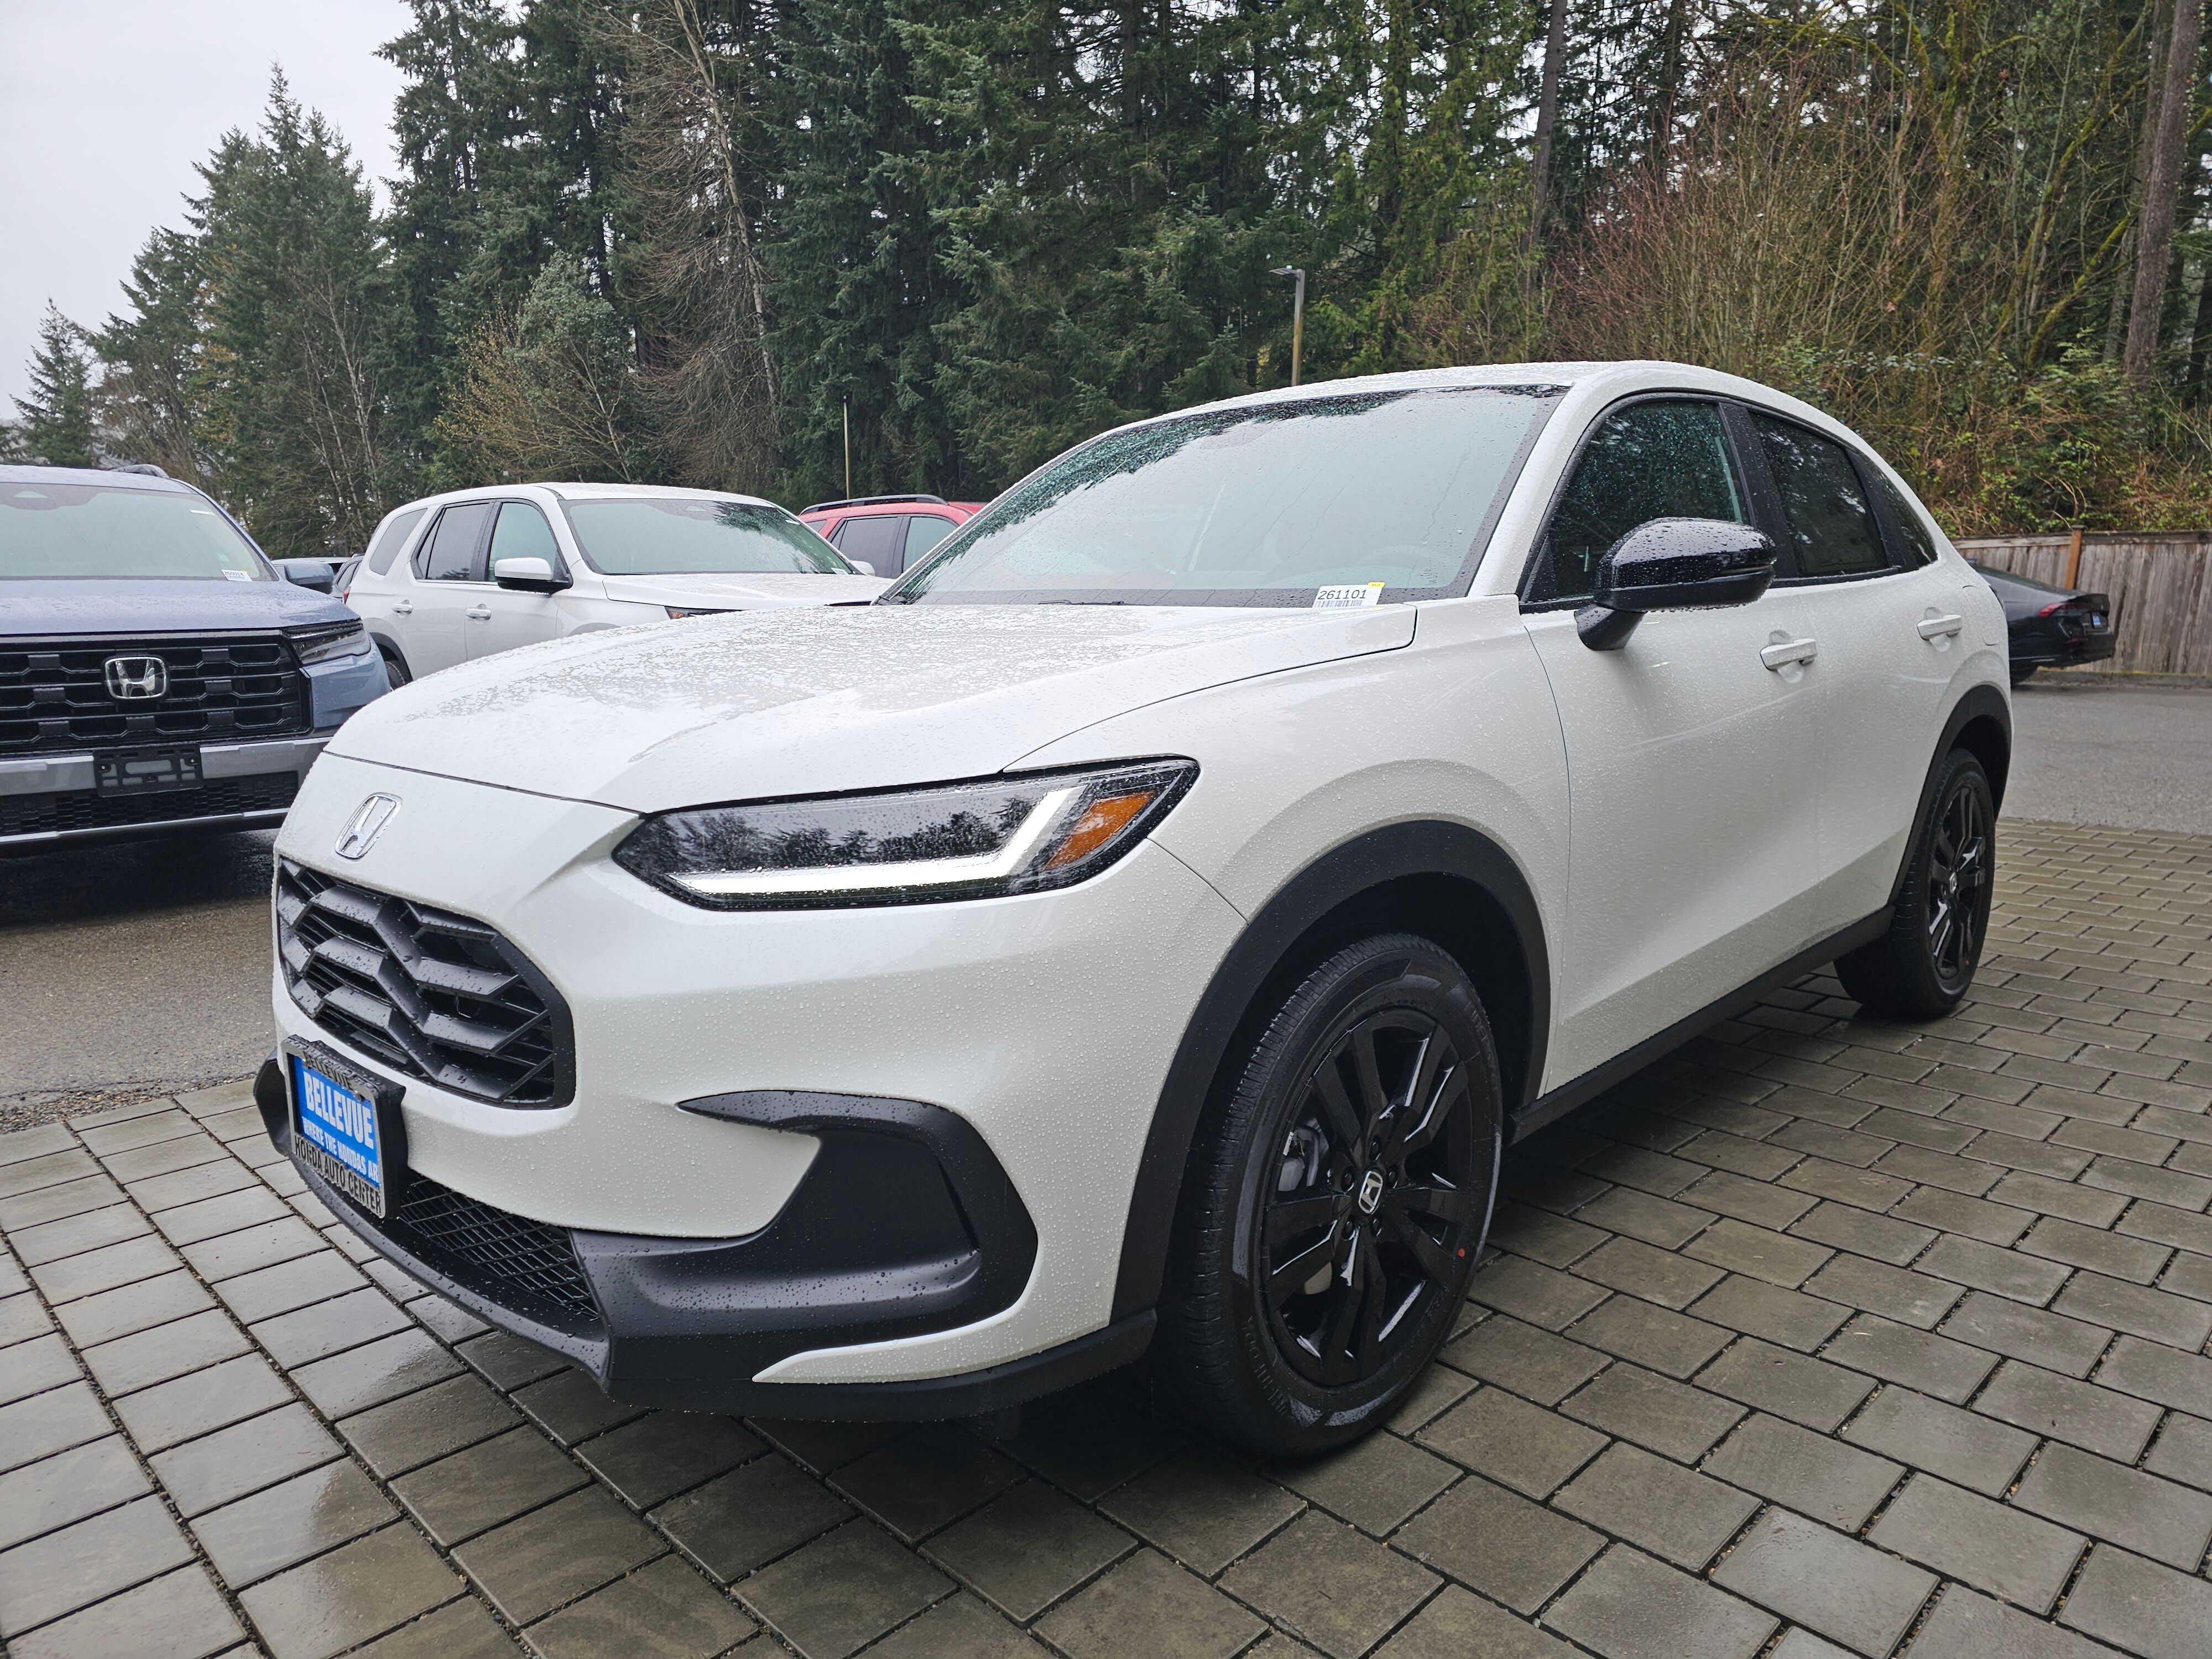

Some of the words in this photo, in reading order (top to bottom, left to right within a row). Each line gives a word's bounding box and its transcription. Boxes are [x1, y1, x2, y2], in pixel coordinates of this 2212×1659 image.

[1318, 589, 1366, 599] 261101
[304, 1071, 374, 1149] BELLEVUE
[295, 1135, 322, 1172] HONDA
[325, 1156, 345, 1187] AUTO
[348, 1172, 381, 1215] CENTER
[302, 1116, 325, 1146] WHERE
[324, 1131, 337, 1156] THE
[337, 1141, 367, 1175] HONDAS
